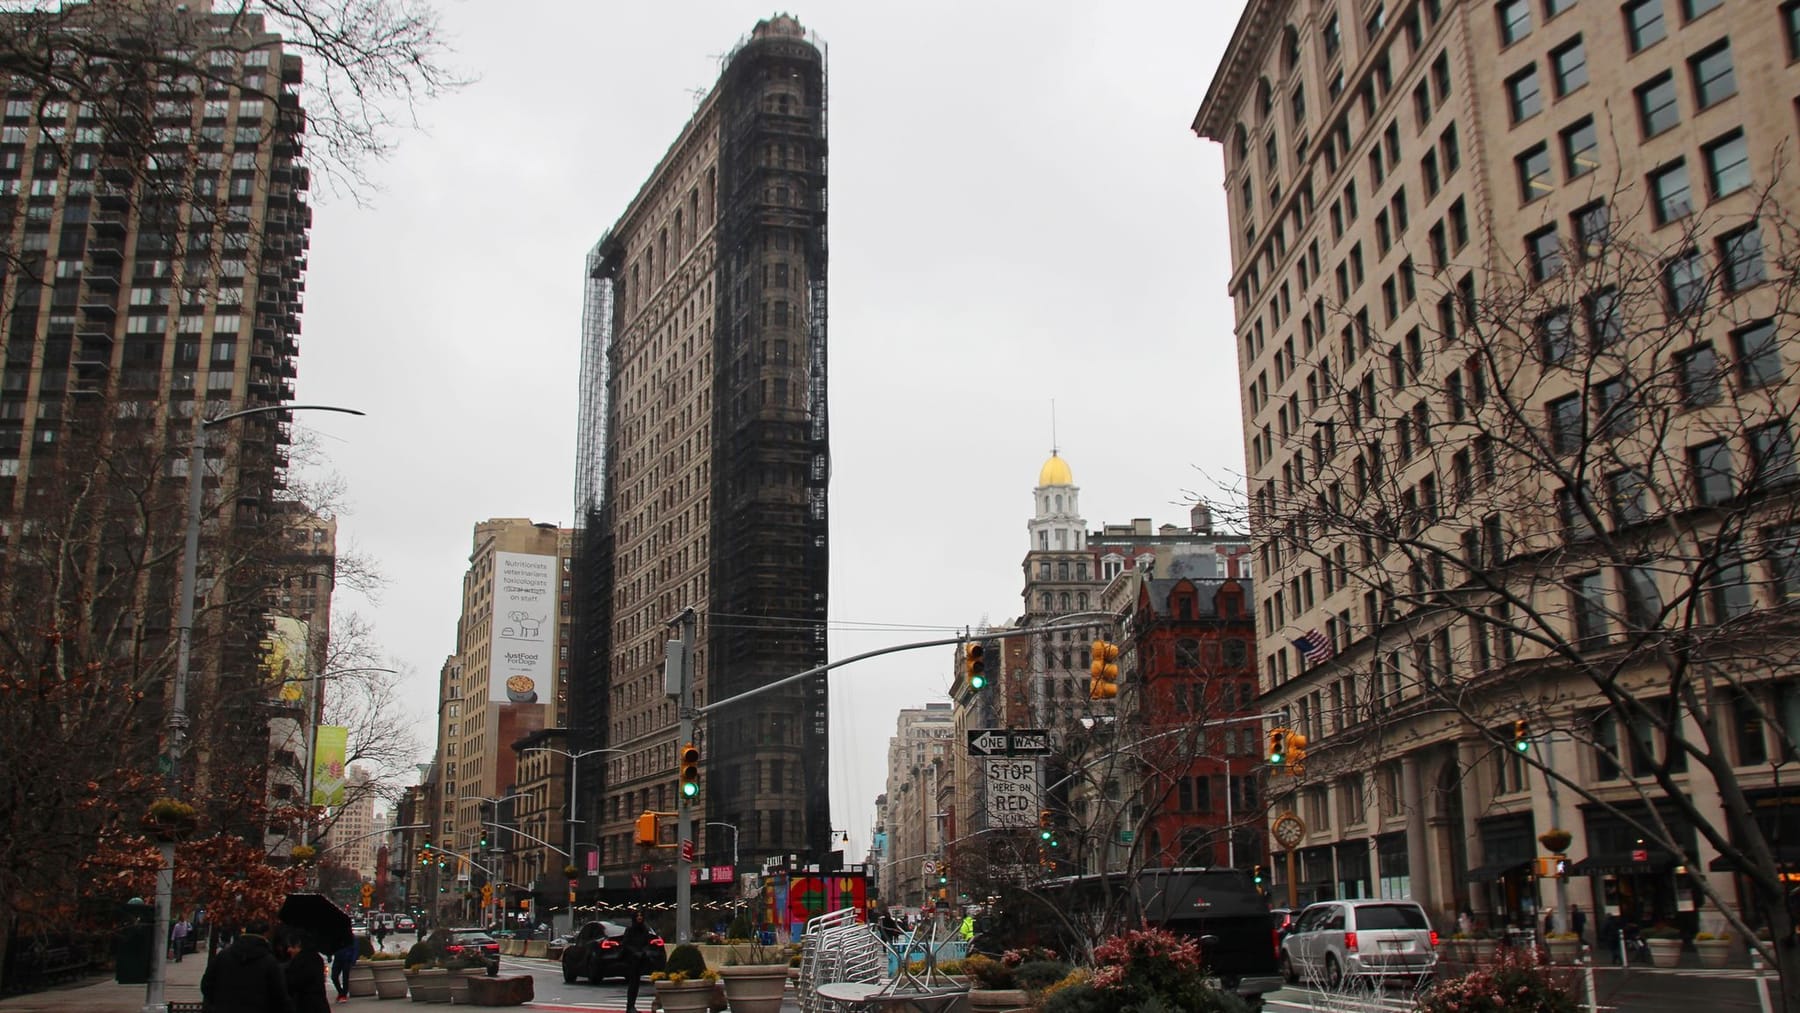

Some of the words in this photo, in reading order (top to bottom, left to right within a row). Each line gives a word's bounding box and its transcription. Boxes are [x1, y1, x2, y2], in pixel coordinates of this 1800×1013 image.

[504, 560, 547, 570] Nutritionists
[504, 652, 538, 660] JustFood
[980, 737, 1004, 748] ONE
[1015, 737, 1041, 748] WAY
[990, 764, 1033, 780] STOP
[993, 783, 1015, 792] HERE
[1019, 783, 1031, 792] ON
[996, 795, 1029, 811] RED
